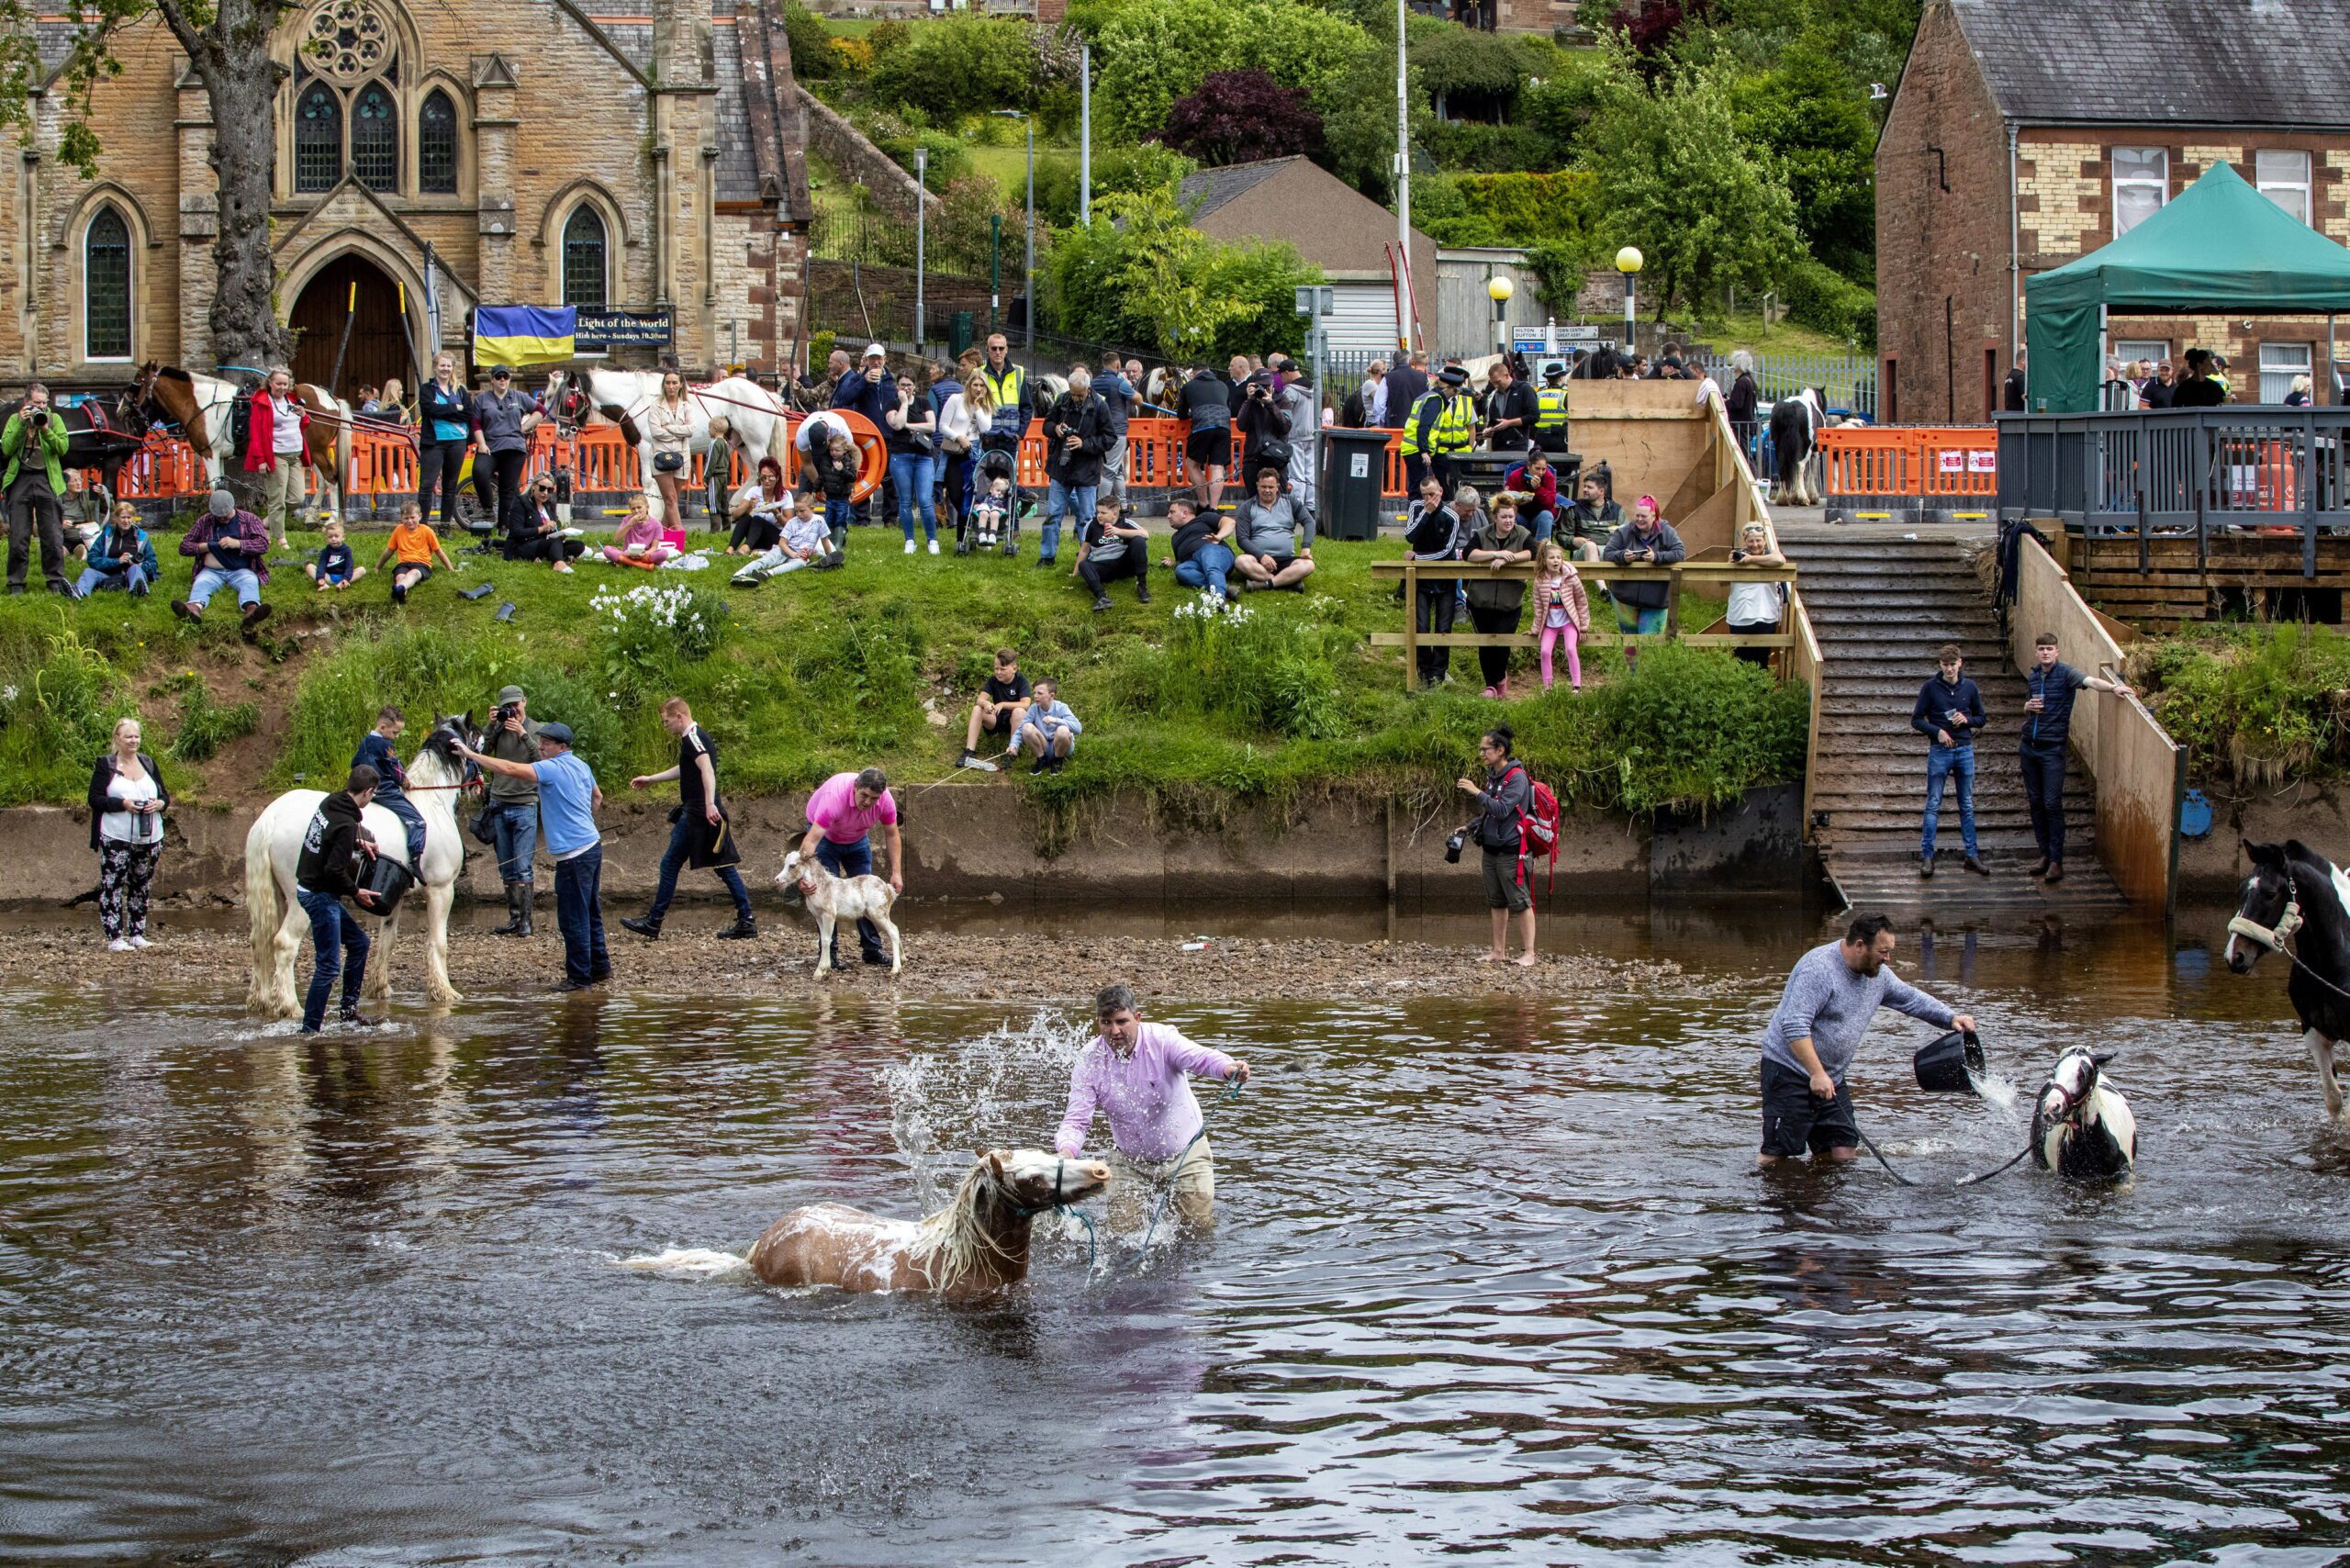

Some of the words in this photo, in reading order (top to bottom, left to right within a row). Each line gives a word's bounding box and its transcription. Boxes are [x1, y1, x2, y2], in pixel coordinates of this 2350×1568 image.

[578, 318, 605, 330] Light
[607, 318, 619, 328] of
[621, 318, 636, 328] the
[639, 318, 668, 328] World
[612, 331, 640, 341] Sundays
[329, 554, 342, 563] NIKE
